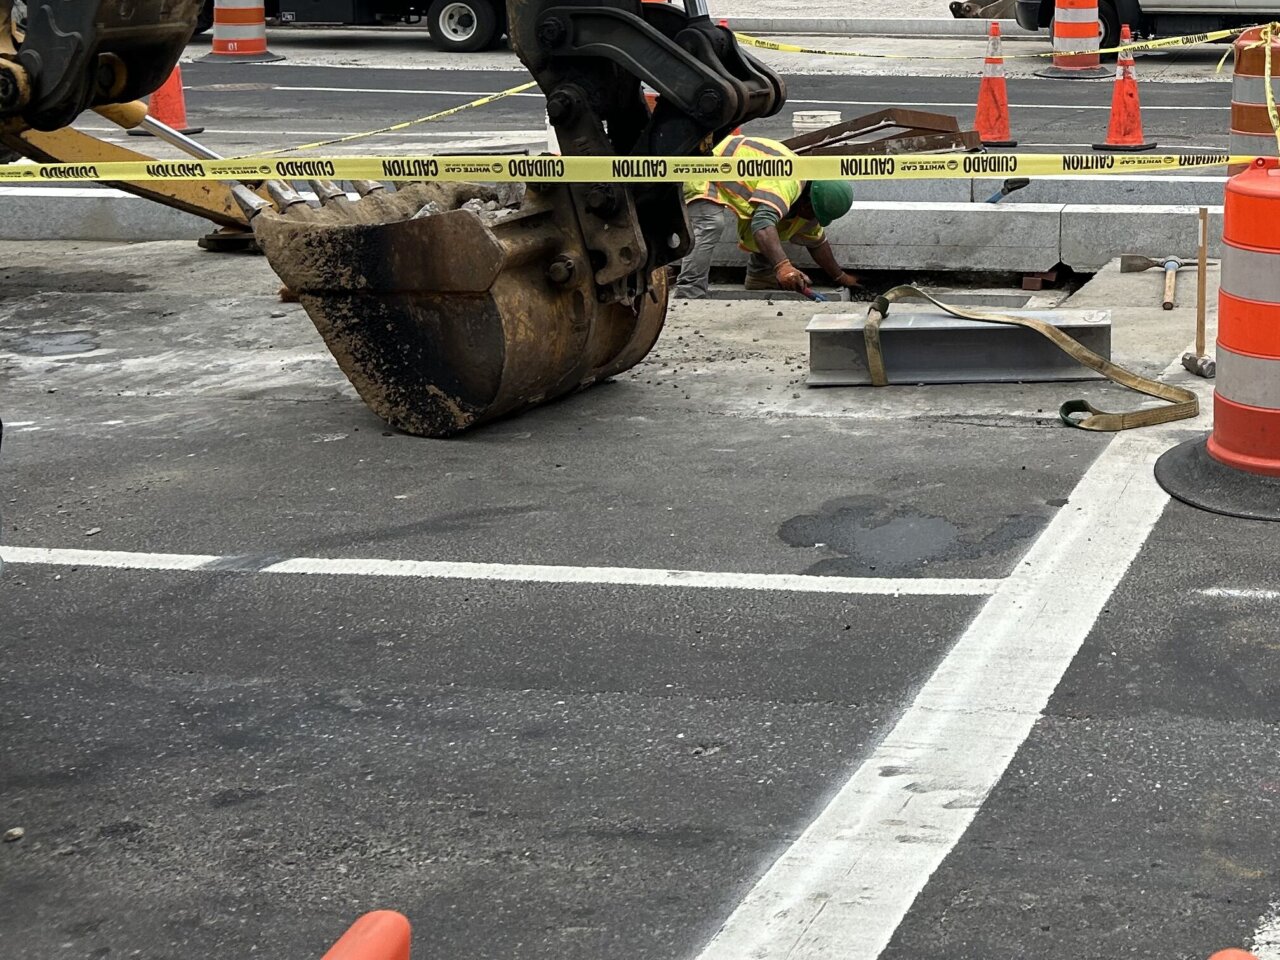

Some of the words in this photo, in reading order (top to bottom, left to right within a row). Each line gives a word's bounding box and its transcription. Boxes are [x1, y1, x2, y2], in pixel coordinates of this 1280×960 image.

[1181, 33, 1209, 45] CAUTION
[146, 163, 206, 178] CAUTION
[276, 160, 335, 177] CUIDADO
[382, 159, 439, 177] CAUTION
[508, 159, 565, 177] CUIDADO
[612, 160, 667, 177] CAUTION
[737, 159, 793, 177] CUIDADO
[840, 158, 895, 176] CAUTION
[963, 156, 1018, 173] CUIDADO
[1063, 155, 1115, 171] CAUTION
